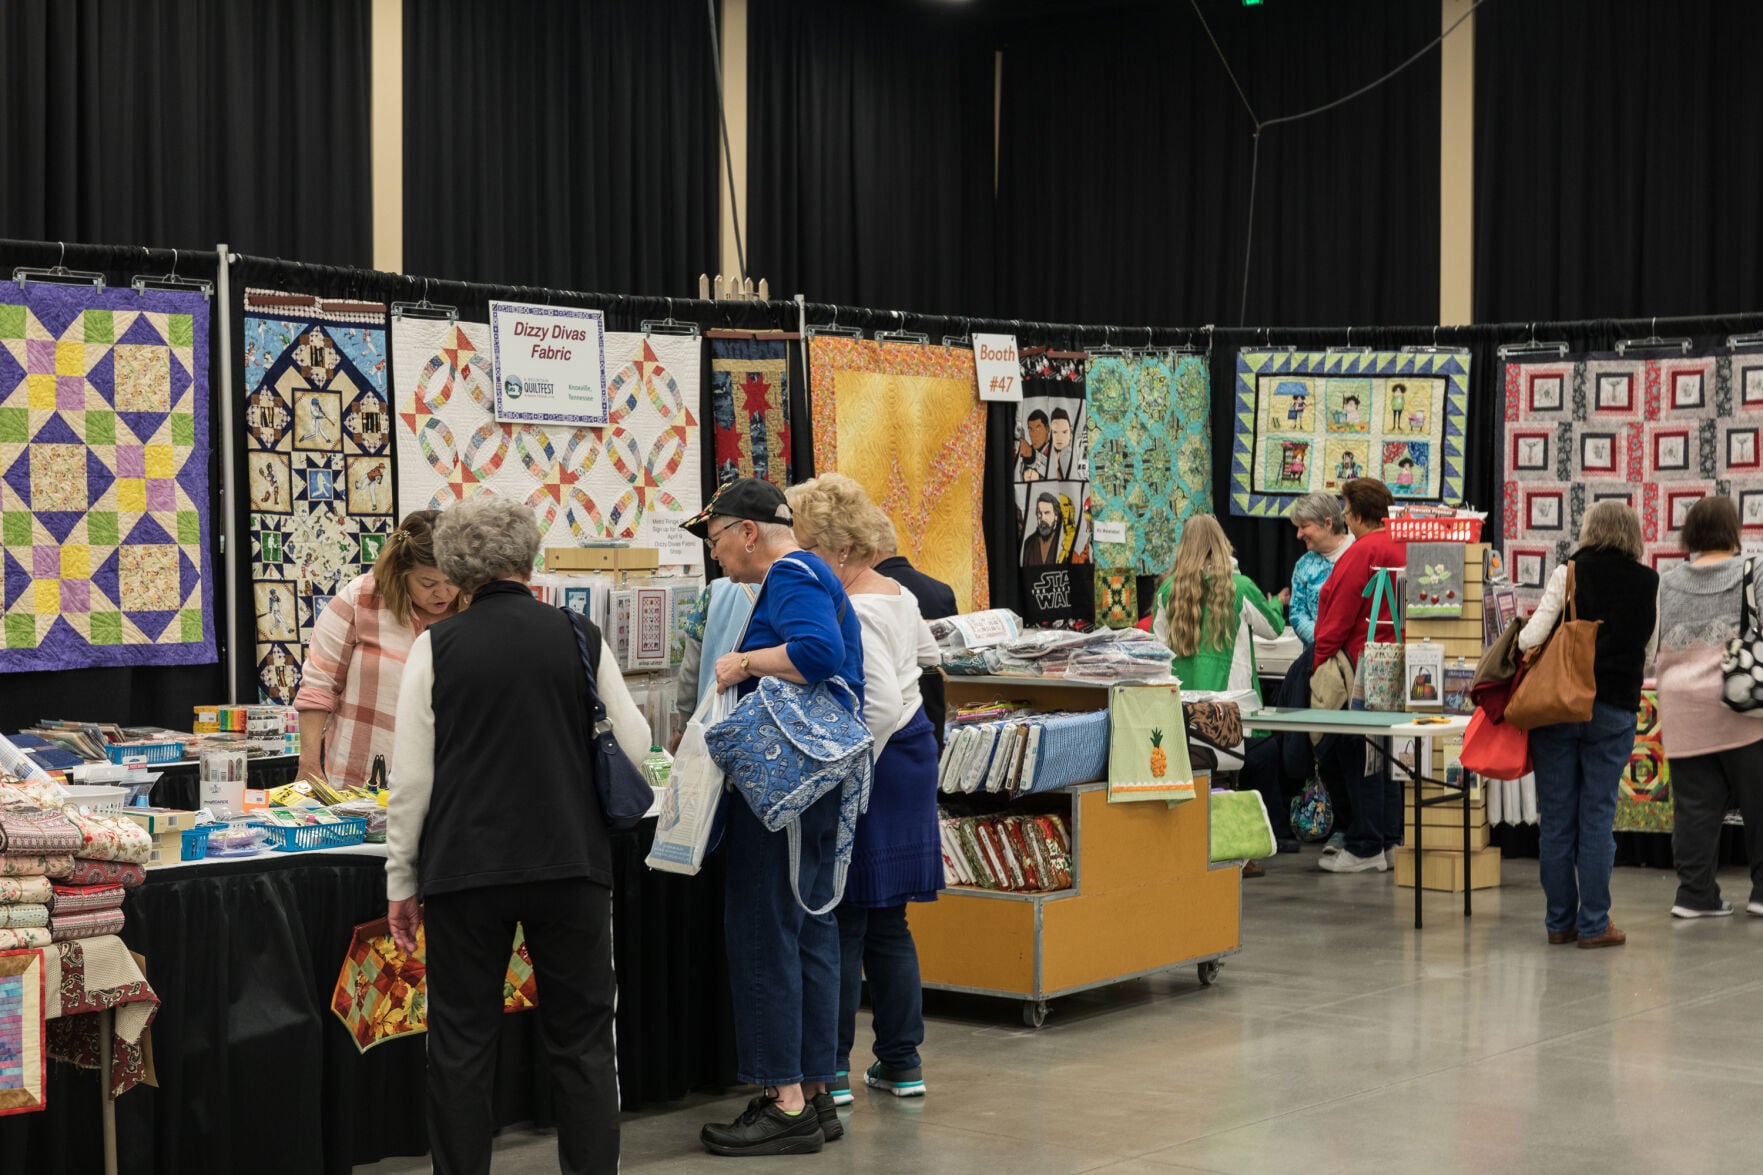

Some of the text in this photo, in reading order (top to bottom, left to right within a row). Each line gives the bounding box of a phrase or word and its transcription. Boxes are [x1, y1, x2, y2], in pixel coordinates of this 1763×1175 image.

[514, 321, 586, 341] Dizzy Divas
[531, 344, 571, 361] Fabric
[980, 344, 1015, 361] Booth
[524, 382, 554, 394] QUILTFEST
[989, 376, 1014, 393] #47
